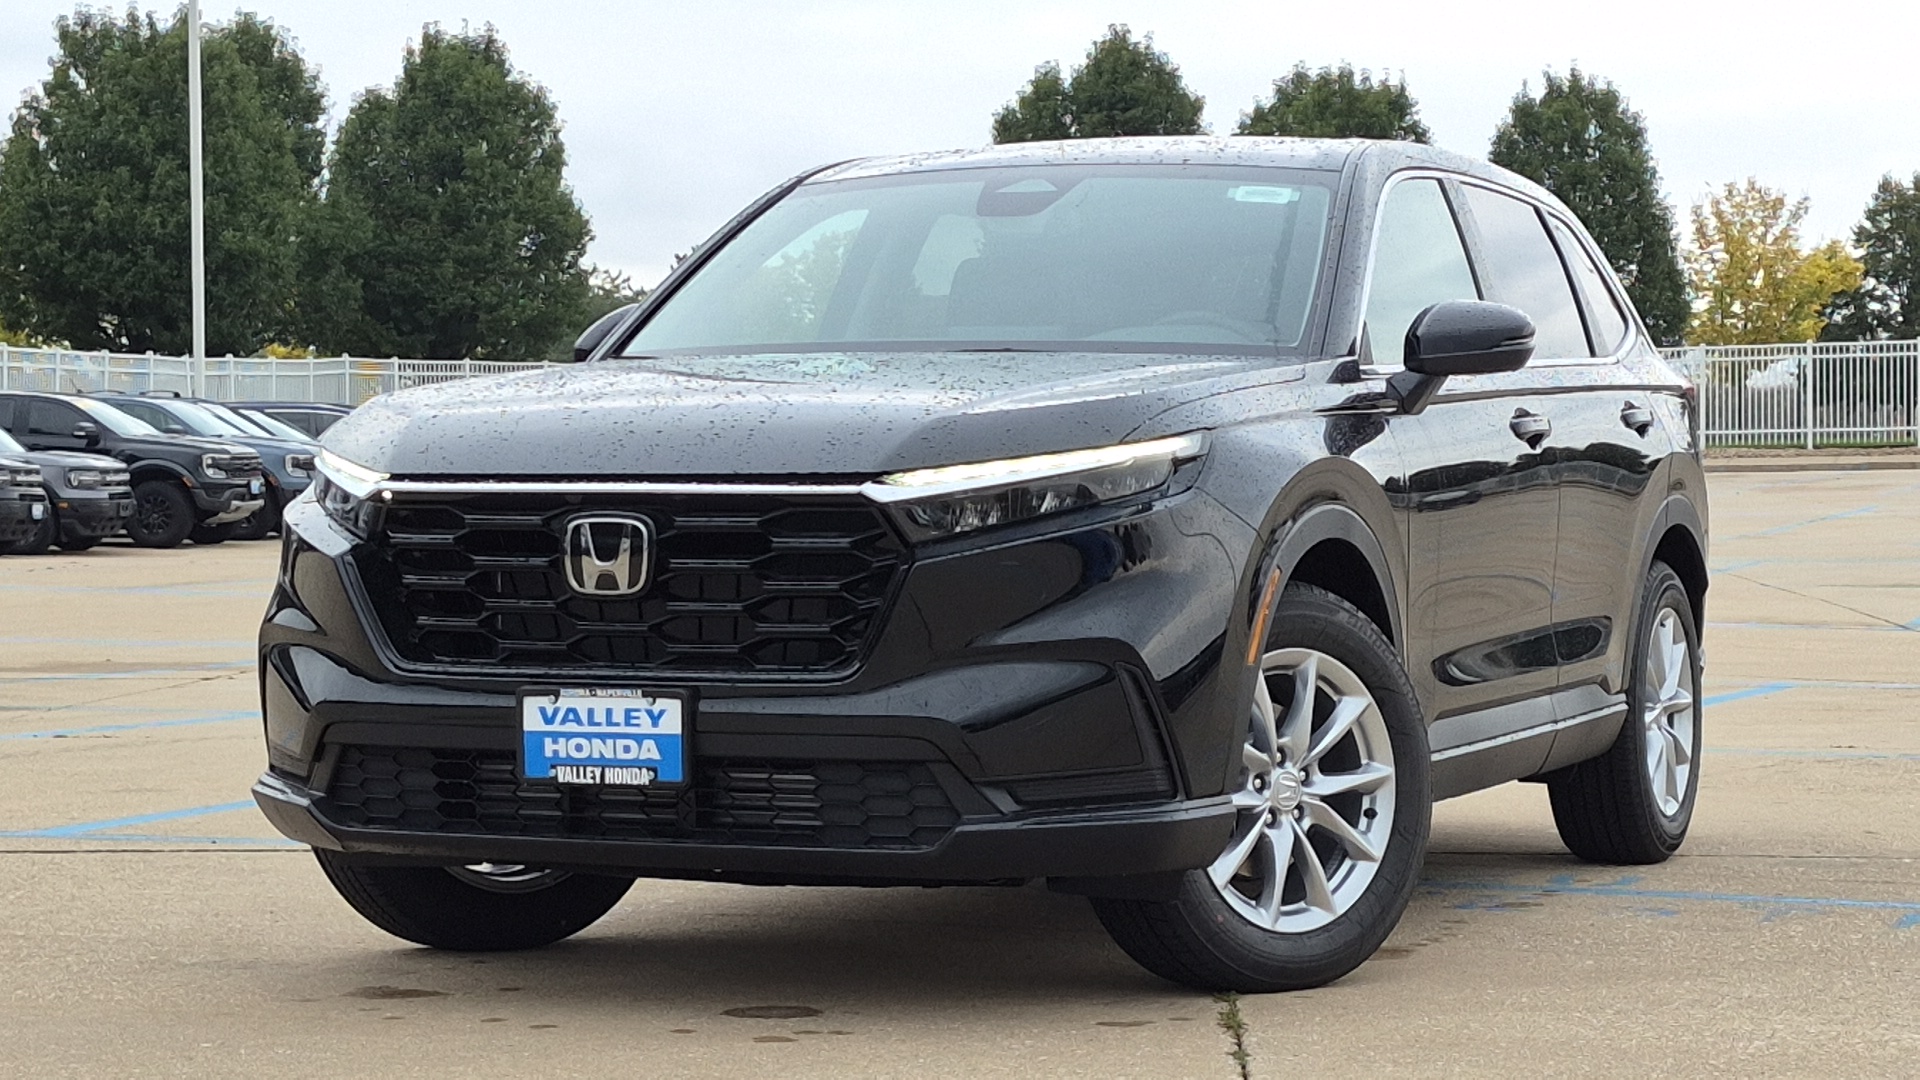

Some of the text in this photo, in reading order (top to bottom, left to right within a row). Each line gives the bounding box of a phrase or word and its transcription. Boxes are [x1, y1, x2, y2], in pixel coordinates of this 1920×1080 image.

[538, 706, 667, 728] VALLEY
[544, 737, 662, 760] HONDA
[556, 765, 650, 786] VALLEY HONDA
